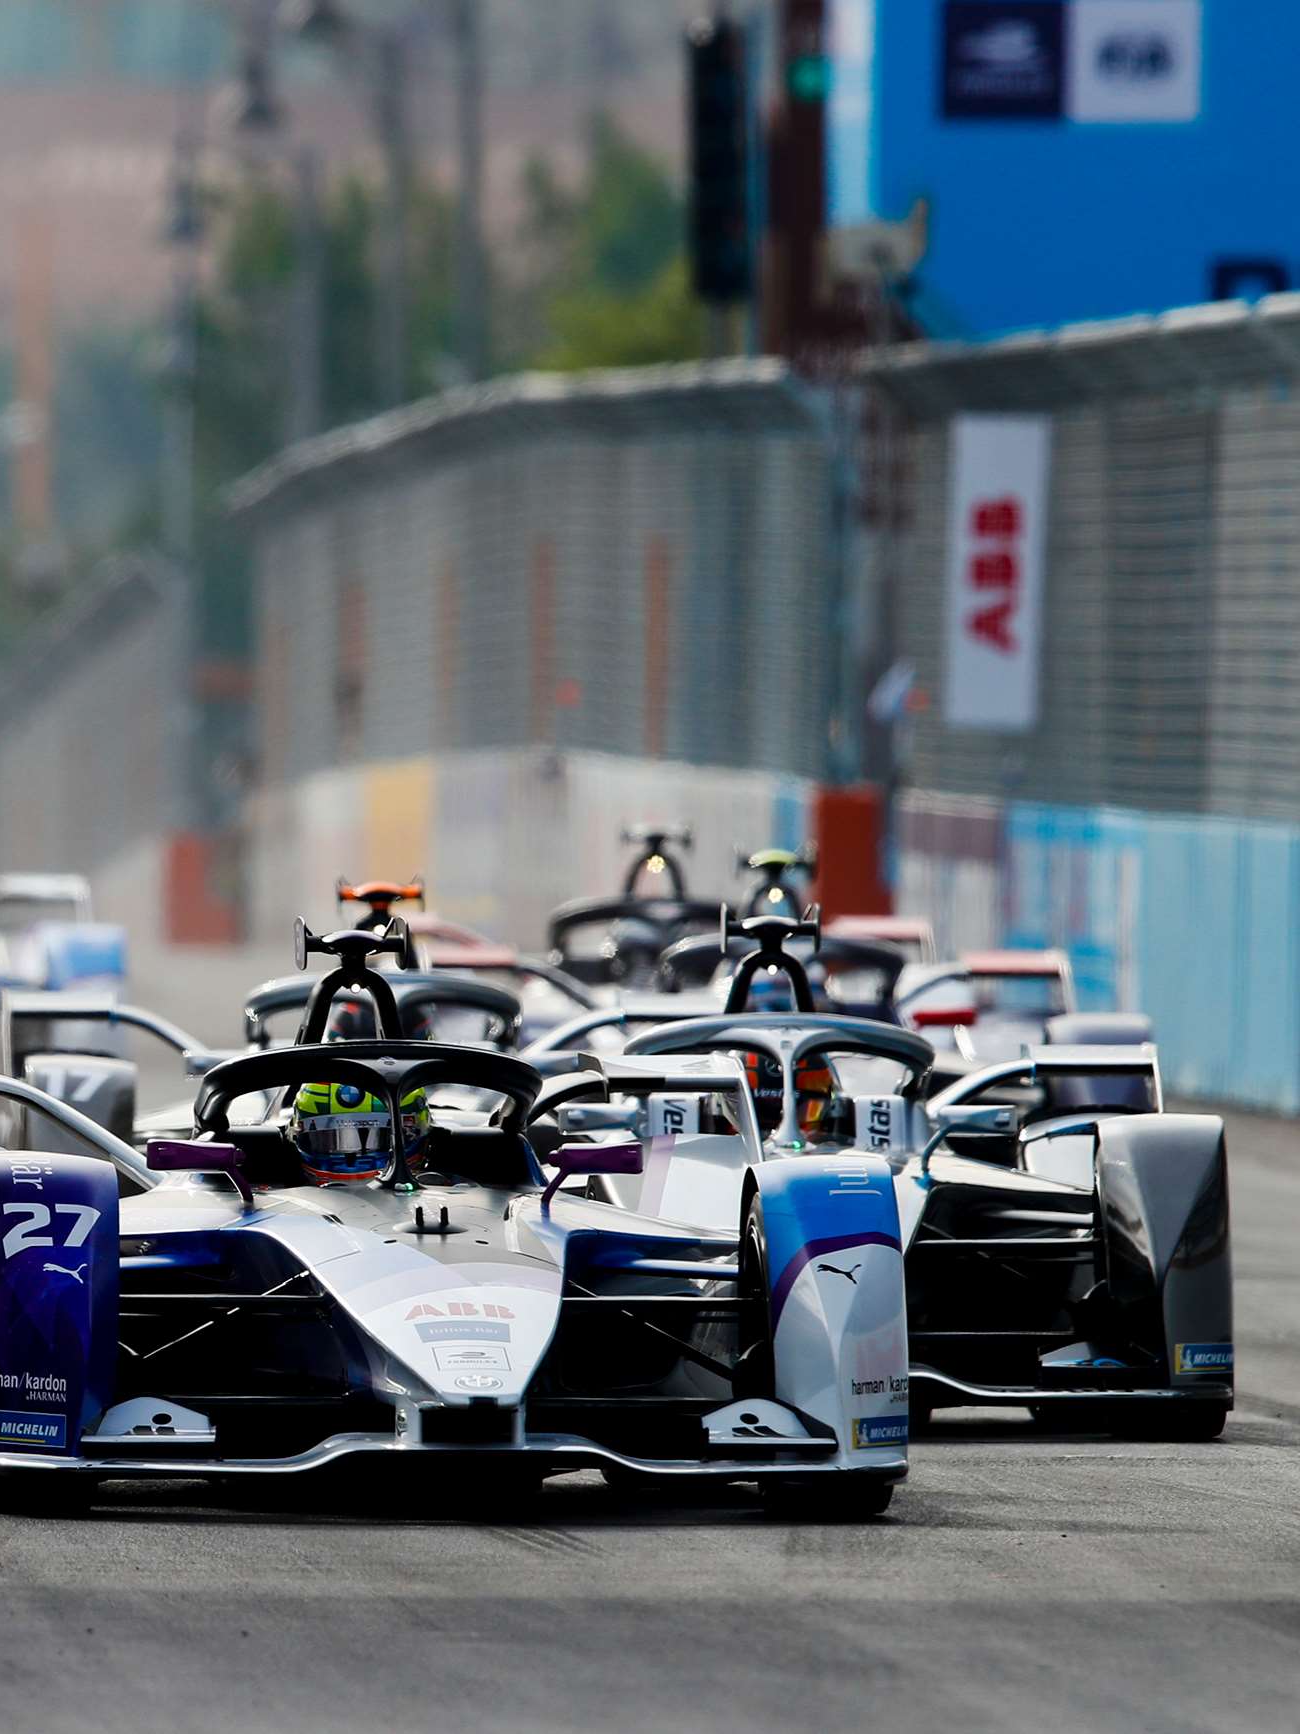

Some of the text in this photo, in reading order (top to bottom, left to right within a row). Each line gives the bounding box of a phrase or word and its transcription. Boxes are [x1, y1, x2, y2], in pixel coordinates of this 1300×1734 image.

[964, 497, 1023, 654] ABB
[39, 1066, 110, 1102] 17
[2, 1202, 102, 1259] 27
[404, 1302, 516, 1321] ABB
[0, 1422, 59, 1437] MICHELIN
